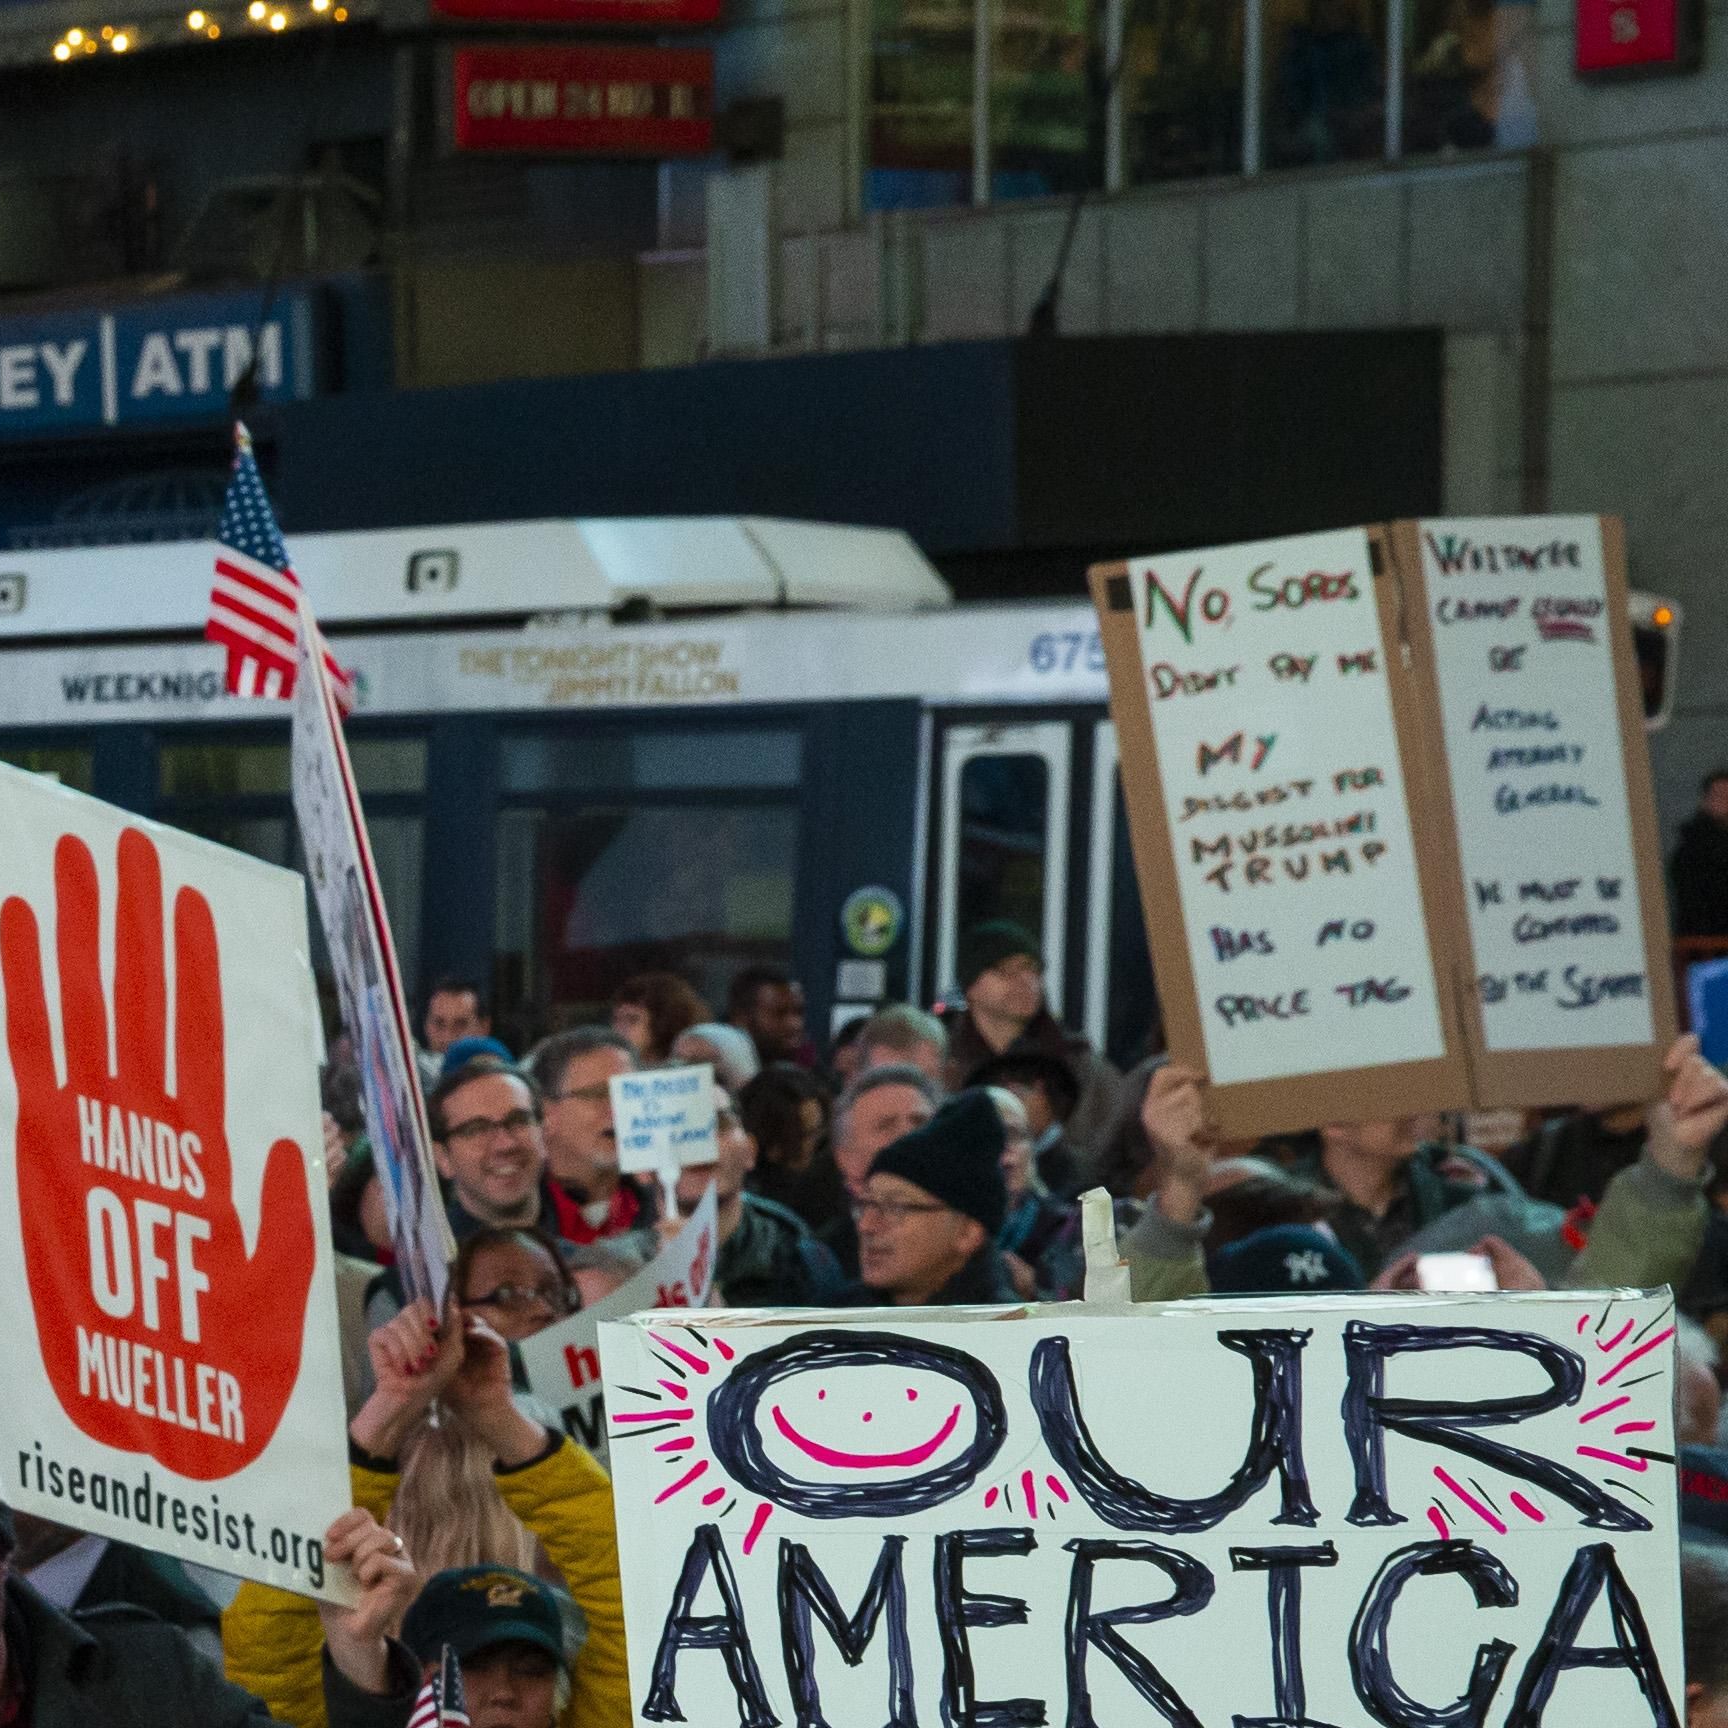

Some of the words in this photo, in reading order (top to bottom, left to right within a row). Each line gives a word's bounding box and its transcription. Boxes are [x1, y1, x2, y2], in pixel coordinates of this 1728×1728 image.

[130, 322, 284, 399] ATM
[61, 661, 218, 702] WEEKNIG
[1204, 841, 1387, 894] TRUMP
[1214, 989, 1313, 1029] PRICE
[1334, 976, 1413, 1004] TAG
[77, 1096, 206, 1200] HANDS
[86, 1186, 211, 1343] OFF
[76, 1325, 246, 1445] MUELLER
[707, 1319, 1652, 1533] OUR
[18, 1442, 325, 1589] riseandresist.org
